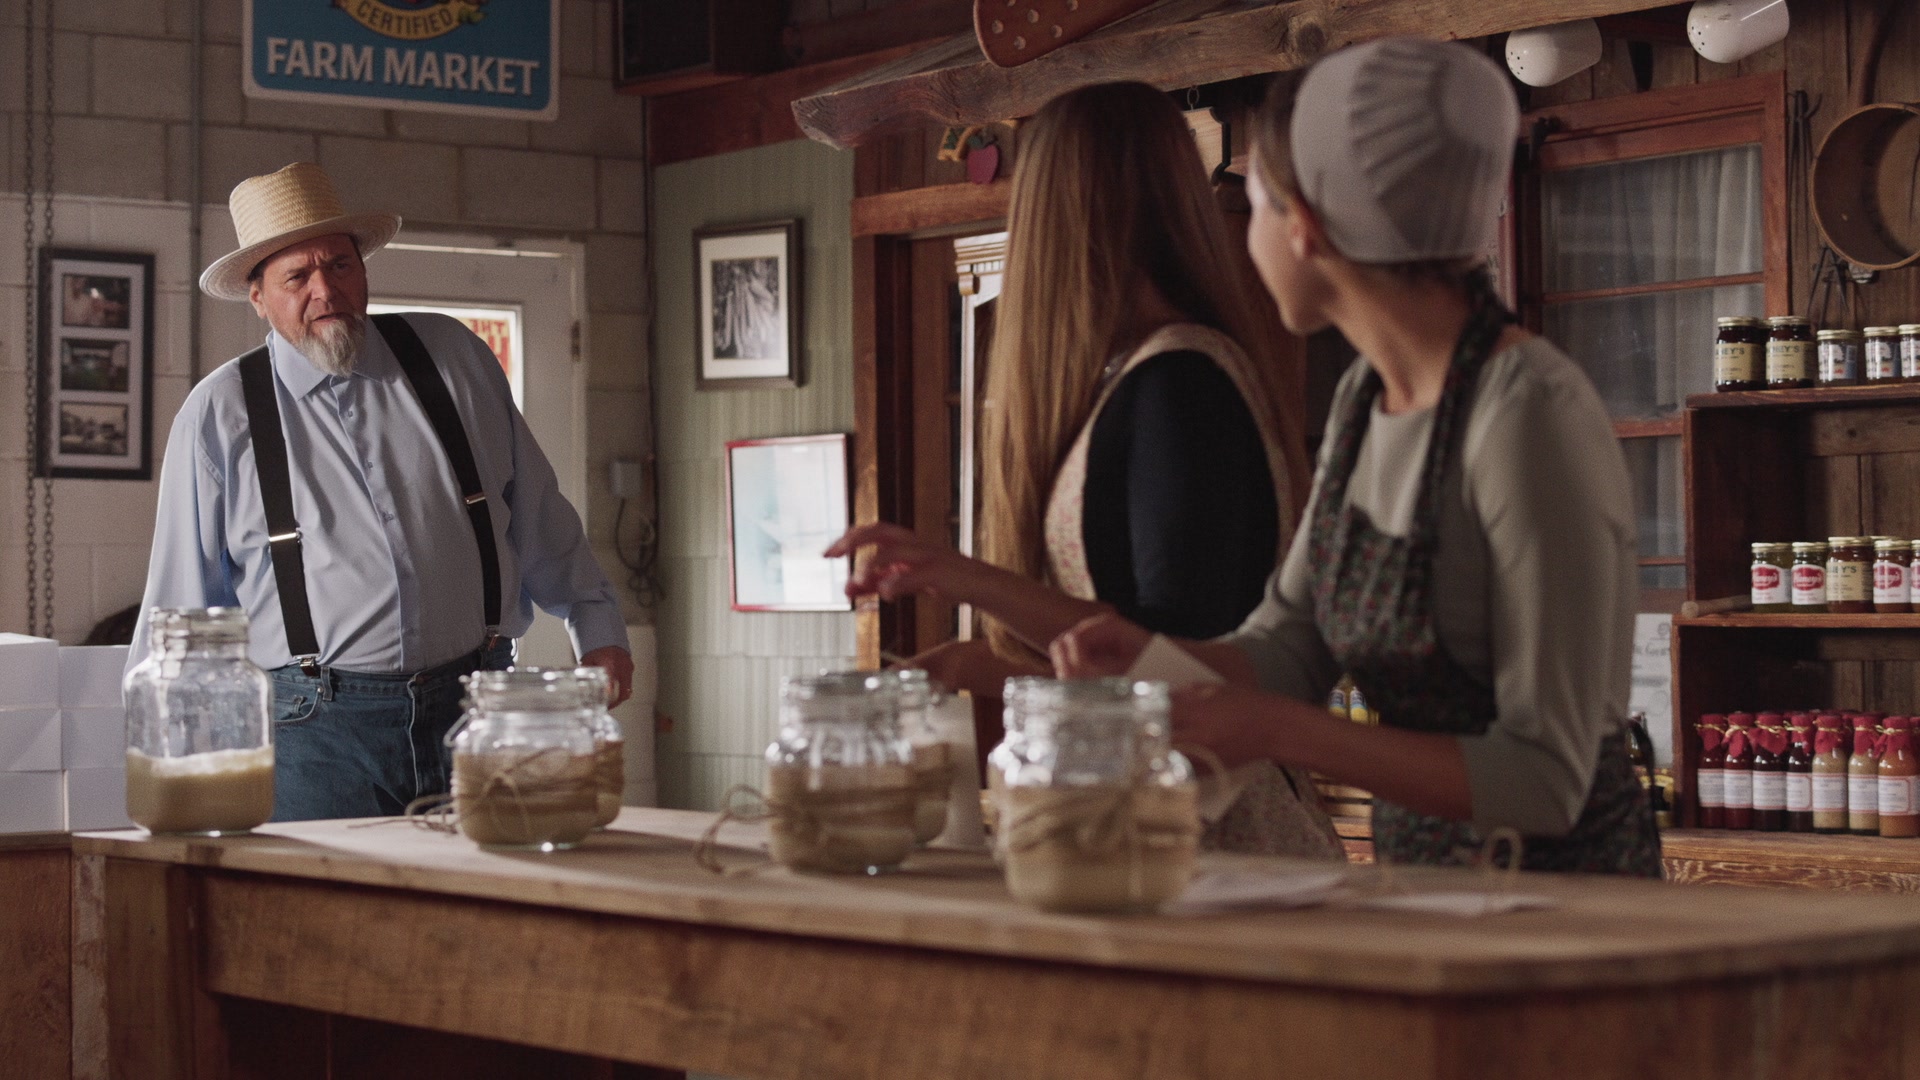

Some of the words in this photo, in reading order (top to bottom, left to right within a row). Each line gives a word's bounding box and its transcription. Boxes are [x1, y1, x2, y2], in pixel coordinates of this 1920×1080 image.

[356, 1, 453, 35] CERTIFIED
[266, 36, 374, 83] FARM
[383, 47, 540, 97] MARKET
